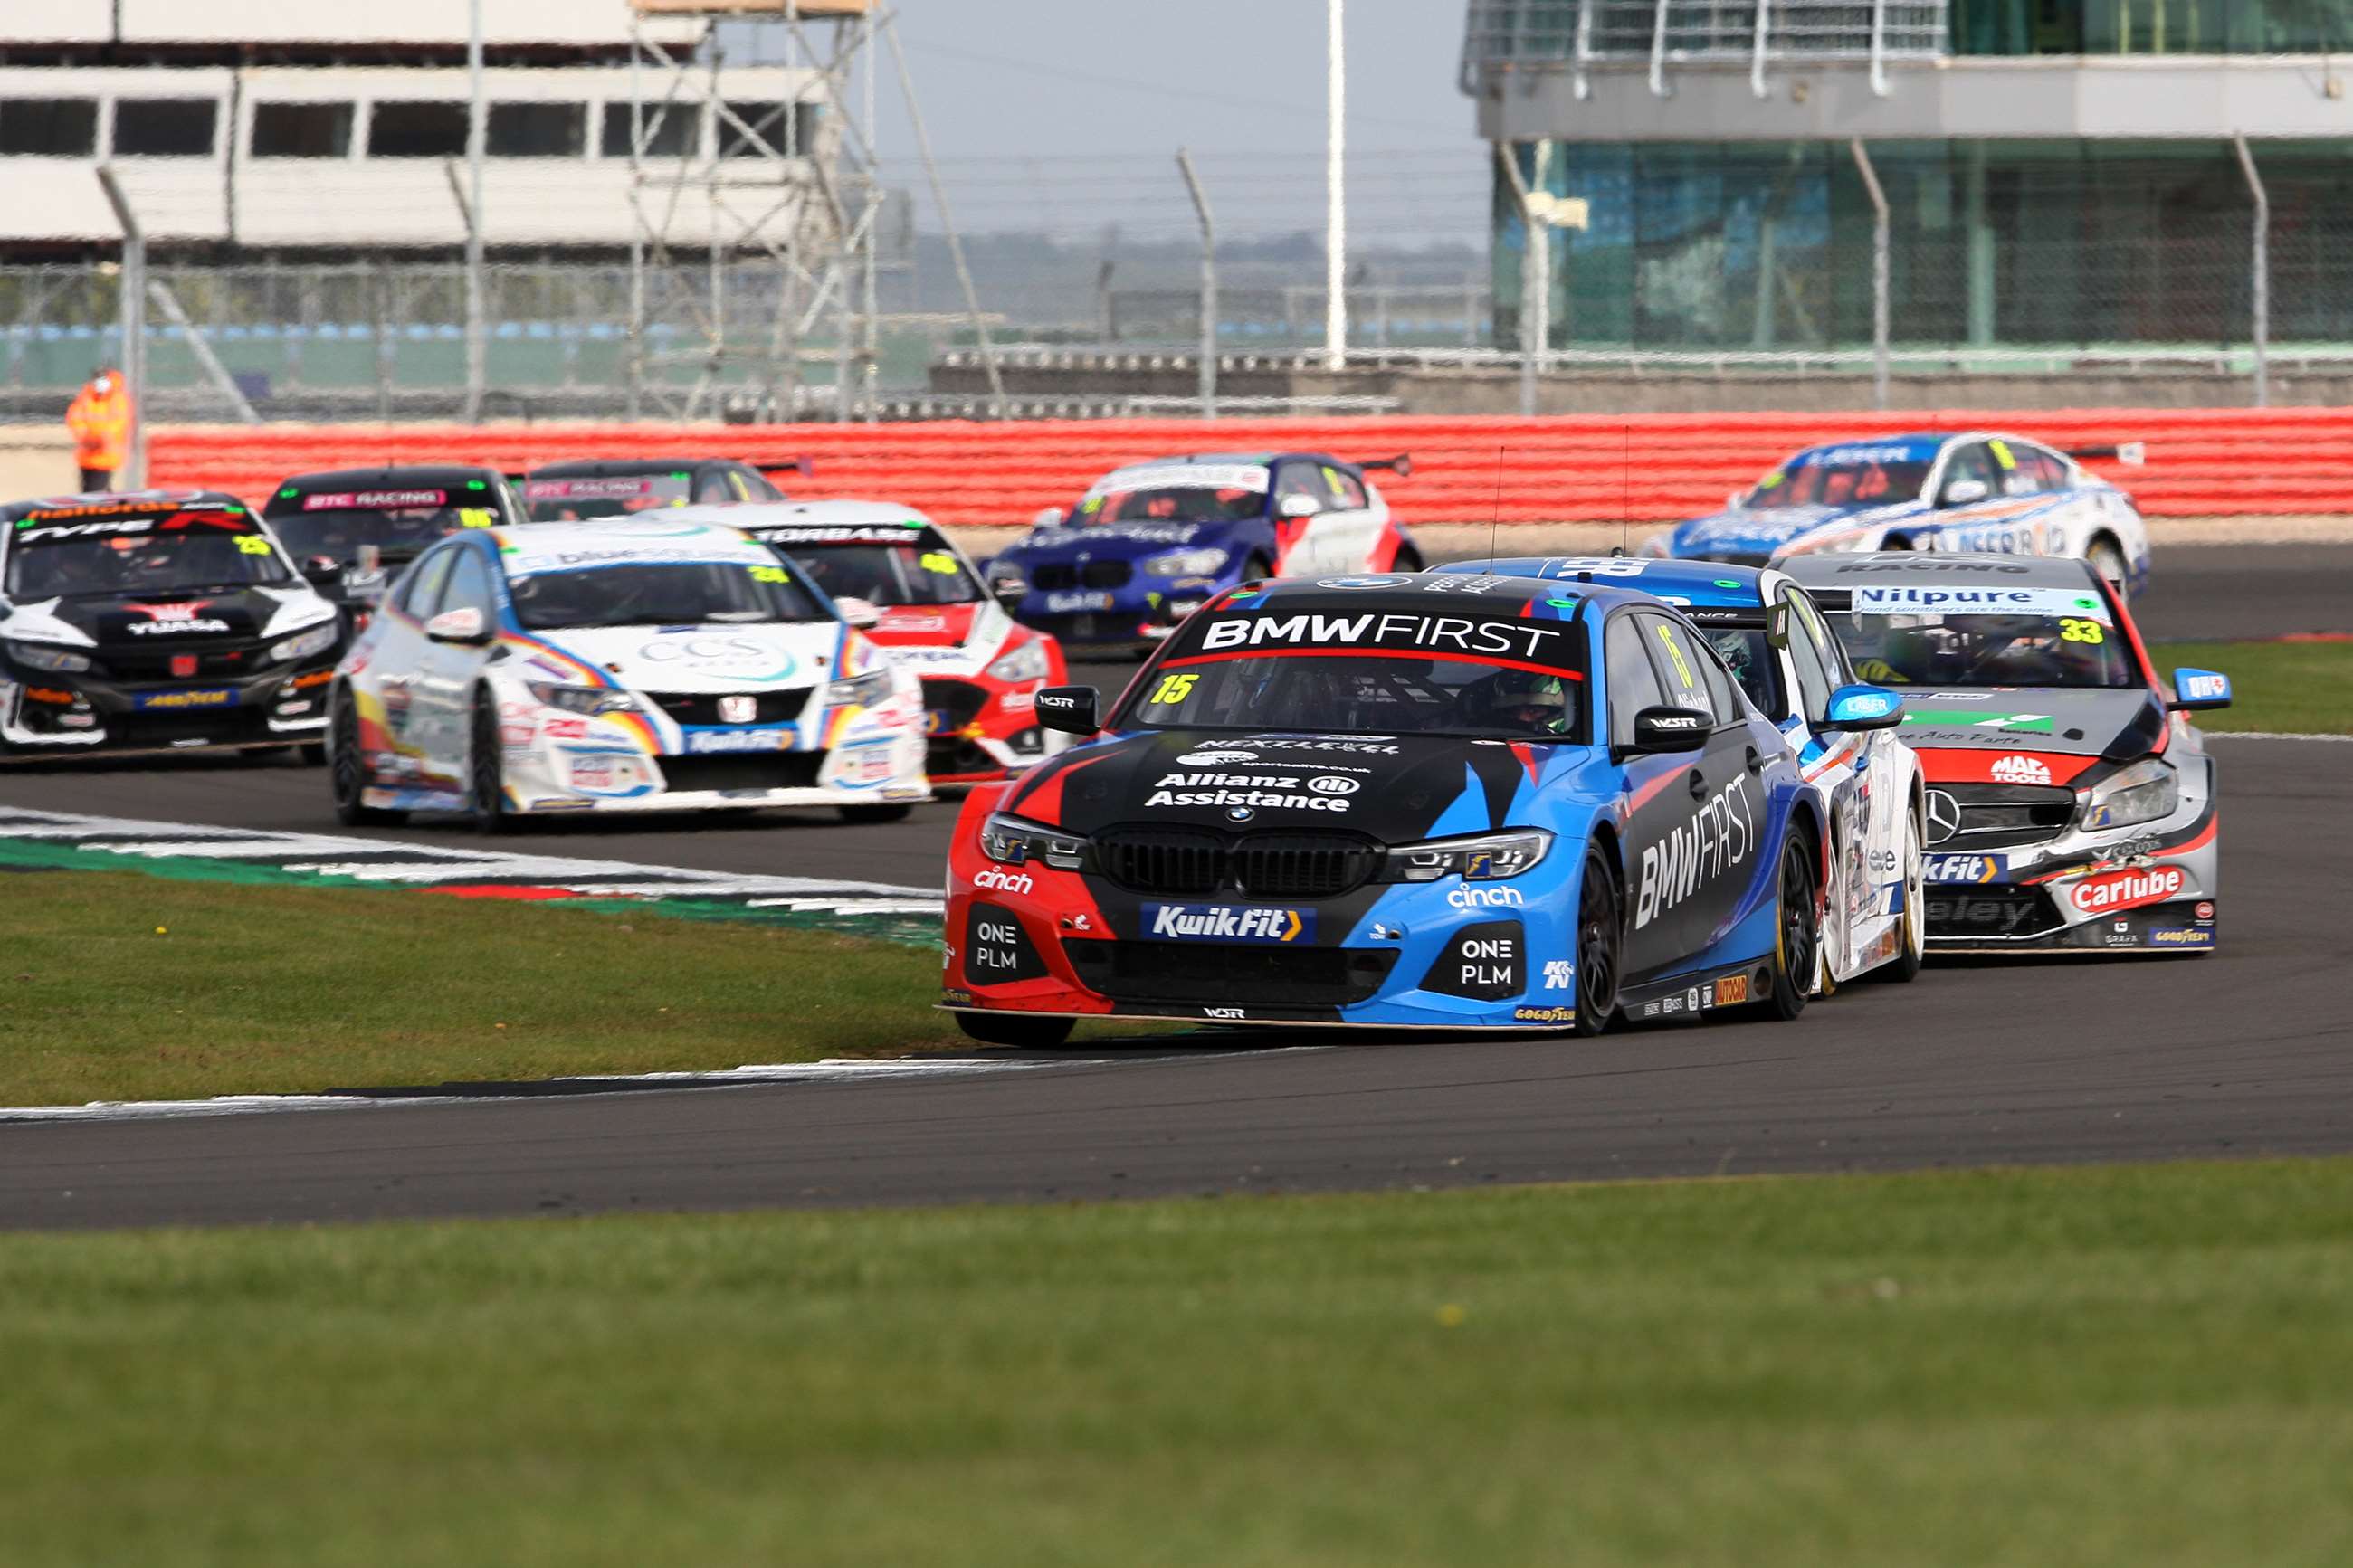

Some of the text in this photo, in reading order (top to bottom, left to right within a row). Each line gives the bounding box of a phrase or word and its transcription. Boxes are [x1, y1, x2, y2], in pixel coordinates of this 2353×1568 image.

[755, 527, 921, 543] TORBASE
[1837, 565, 2030, 575] RACING
[1862, 588, 2033, 605] Nilpure
[2060, 618, 2104, 644] 33
[638, 637, 764, 662] CCS
[1150, 674, 1200, 705] 15
[1040, 695, 1074, 708] WSR
[1650, 717, 1698, 728] WSR
[1991, 755, 2051, 775] MAC
[1155, 773, 1300, 789] Allianz
[1990, 774, 2052, 785] TOOLS
[1144, 790, 1351, 813] Assistance
[973, 866, 1034, 896] cinch
[2075, 870, 2180, 909] Carlube
[1447, 883, 1524, 908] cinch
[976, 921, 1017, 945] ONE
[976, 946, 1017, 971] PLM
[1462, 939, 1513, 960] ONE
[1462, 965, 1512, 985] PLM
[1204, 1007, 1246, 1020] WSR
